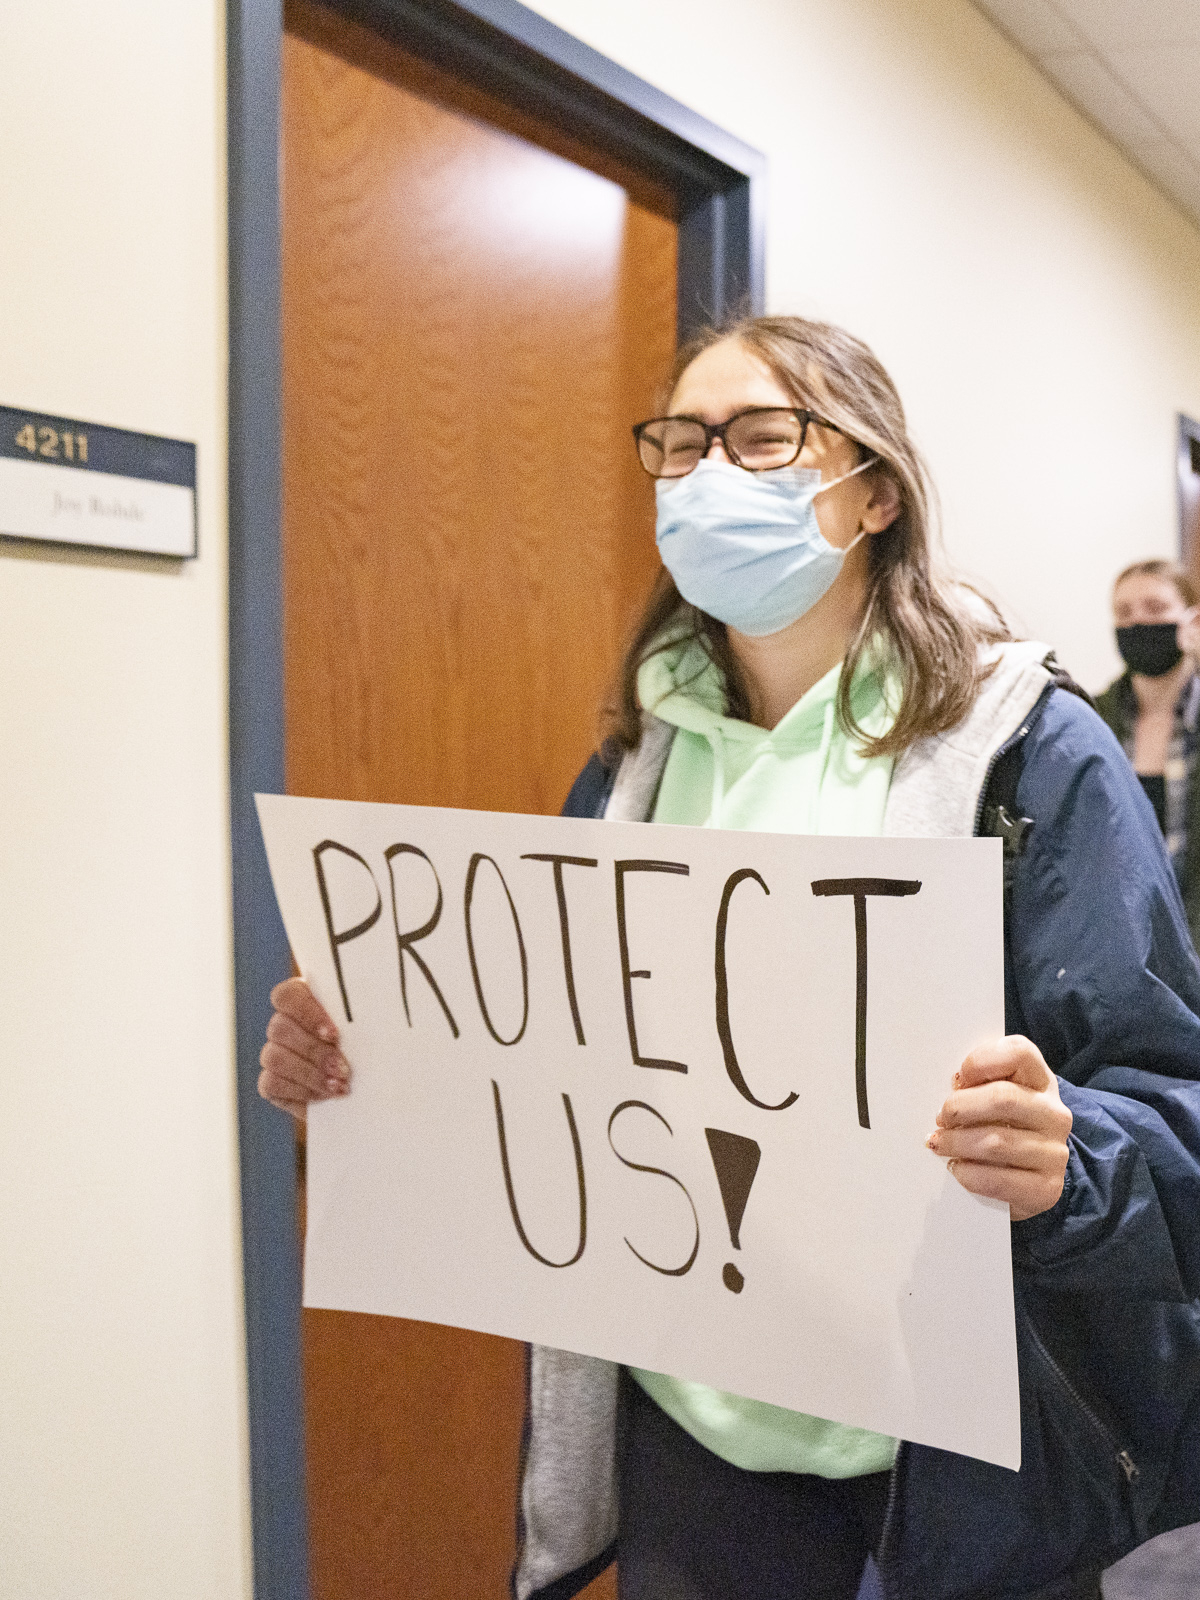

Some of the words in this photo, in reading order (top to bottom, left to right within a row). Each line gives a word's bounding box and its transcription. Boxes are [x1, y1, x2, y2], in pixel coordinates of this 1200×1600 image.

[15, 423, 89, 463] 4211
[312, 839, 923, 1130] PROTECT
[491, 1078, 762, 1294] US!
